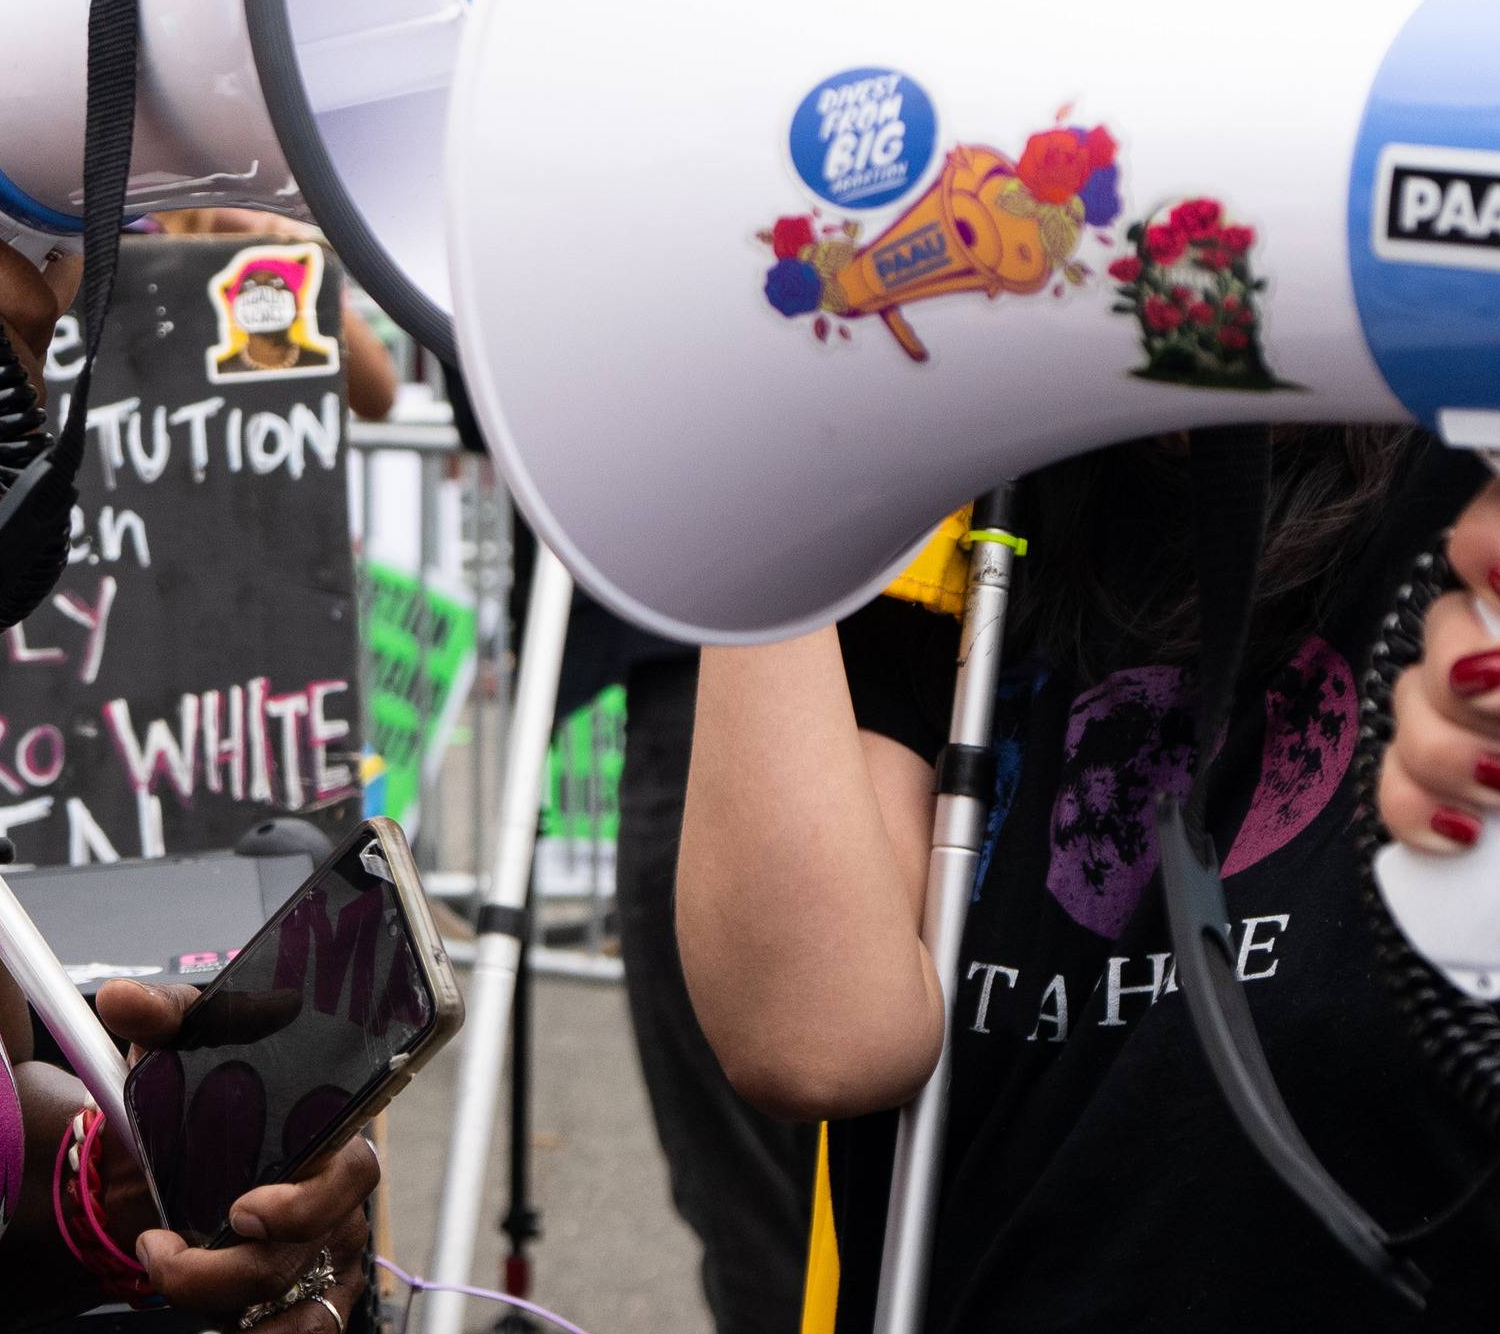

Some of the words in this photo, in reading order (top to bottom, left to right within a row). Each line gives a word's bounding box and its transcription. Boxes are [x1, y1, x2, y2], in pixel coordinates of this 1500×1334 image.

[816, 73, 901, 115] DIVEST
[819, 94, 903, 142] FROM
[823, 119, 906, 182] BIG
[103, 675, 356, 810] WHITE
[966, 912, 1290, 1044] TAHE
